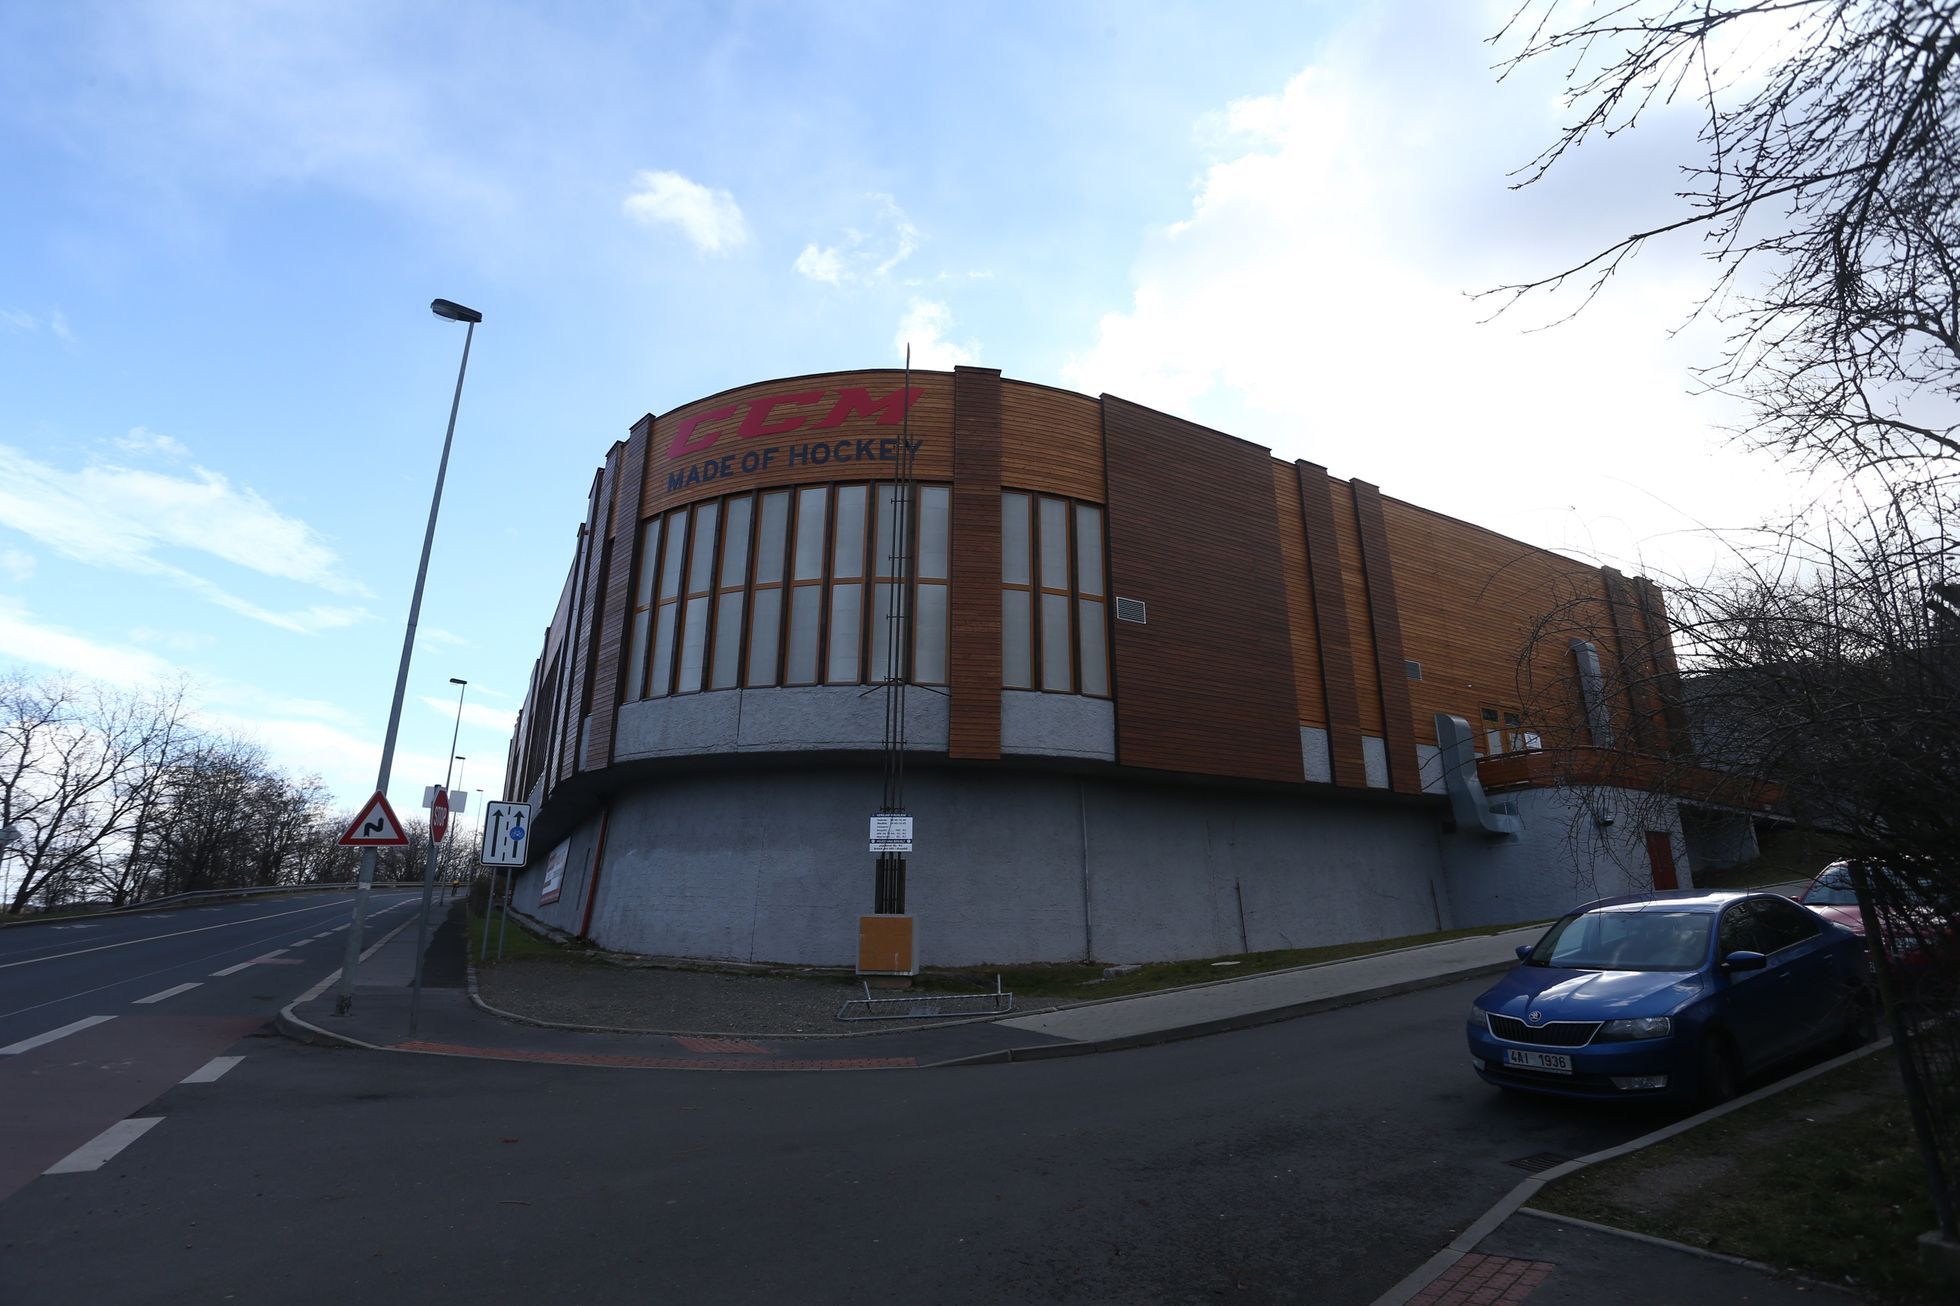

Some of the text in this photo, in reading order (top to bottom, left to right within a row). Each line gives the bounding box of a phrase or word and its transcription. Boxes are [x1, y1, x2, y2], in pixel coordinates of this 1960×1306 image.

[666, 386, 925, 459] CCM
[666, 438, 924, 493] MADE OF HOCKEY
[434, 806, 447, 826] STOP
[1538, 1054, 1567, 1068] 1936
